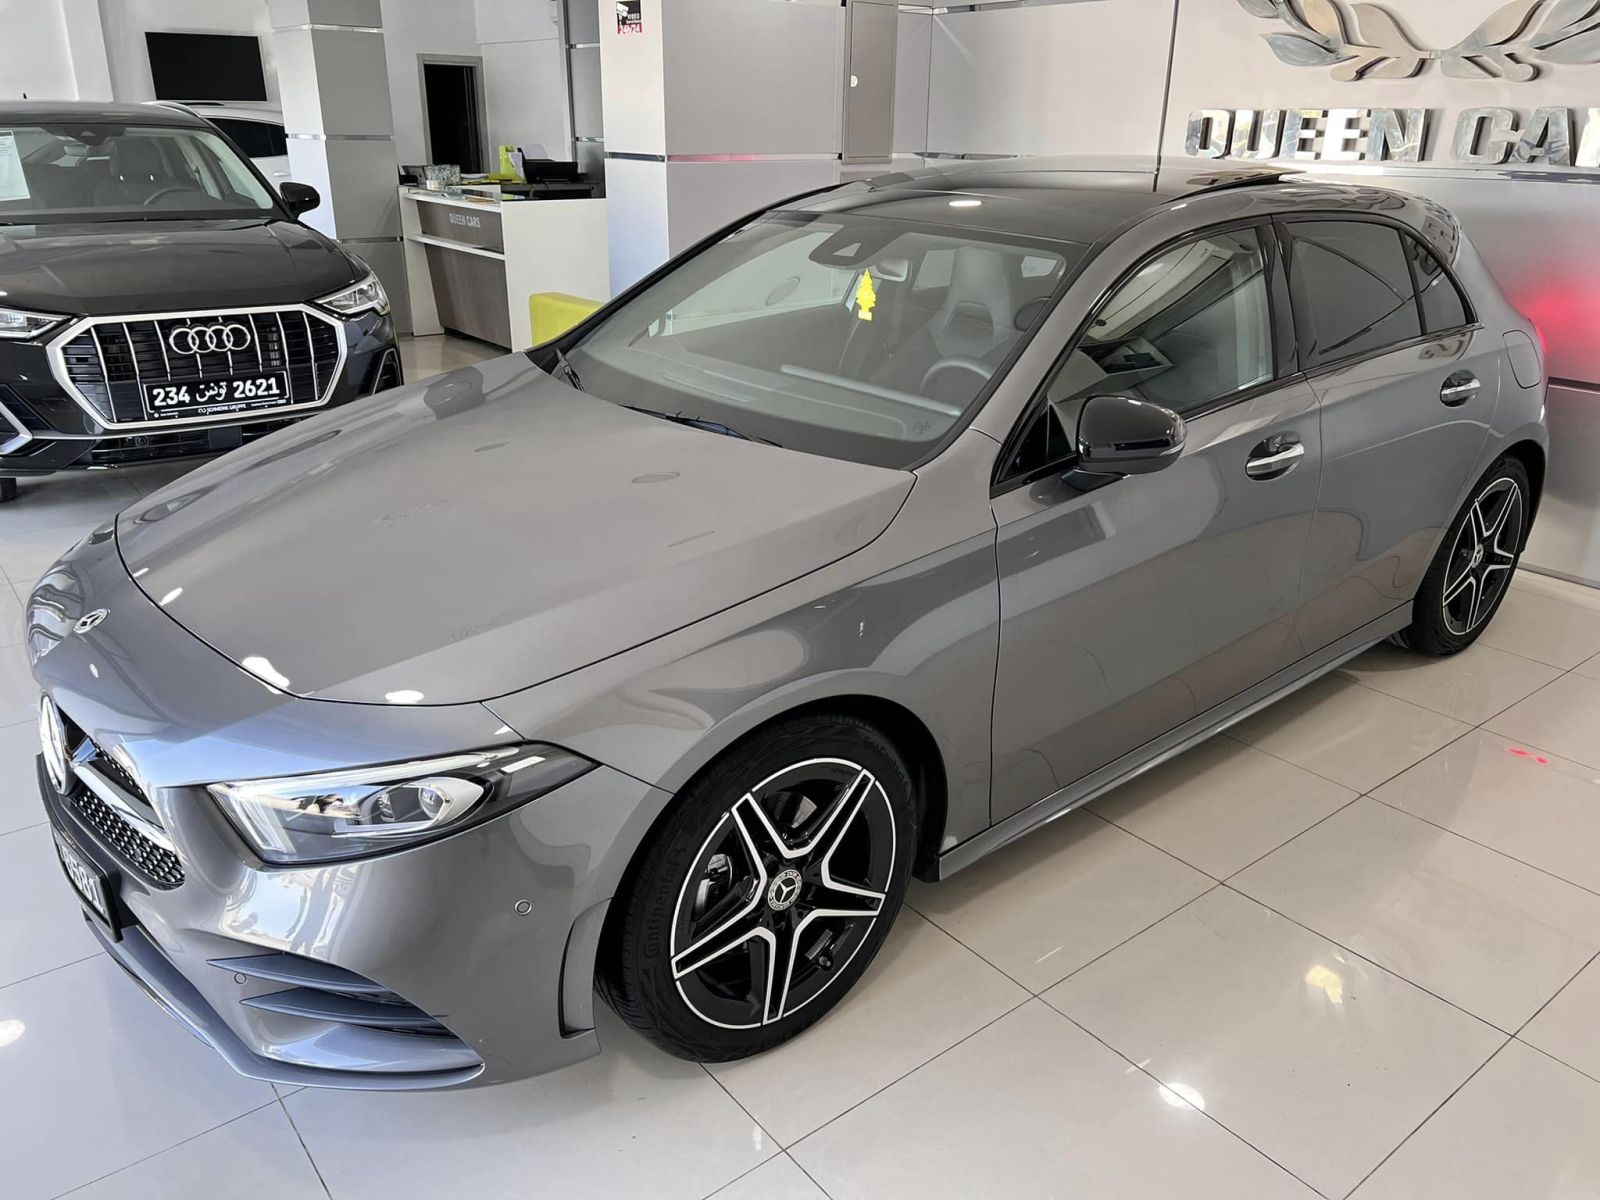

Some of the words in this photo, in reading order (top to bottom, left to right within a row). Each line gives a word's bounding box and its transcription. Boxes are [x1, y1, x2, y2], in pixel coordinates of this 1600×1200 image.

[1185, 107, 1430, 163] QUEEN
[449, 213, 466, 225] QUEEN
[466, 215, 481, 228] CARS
[152, 386, 191, 407] 234
[232, 377, 280, 399] 2621
